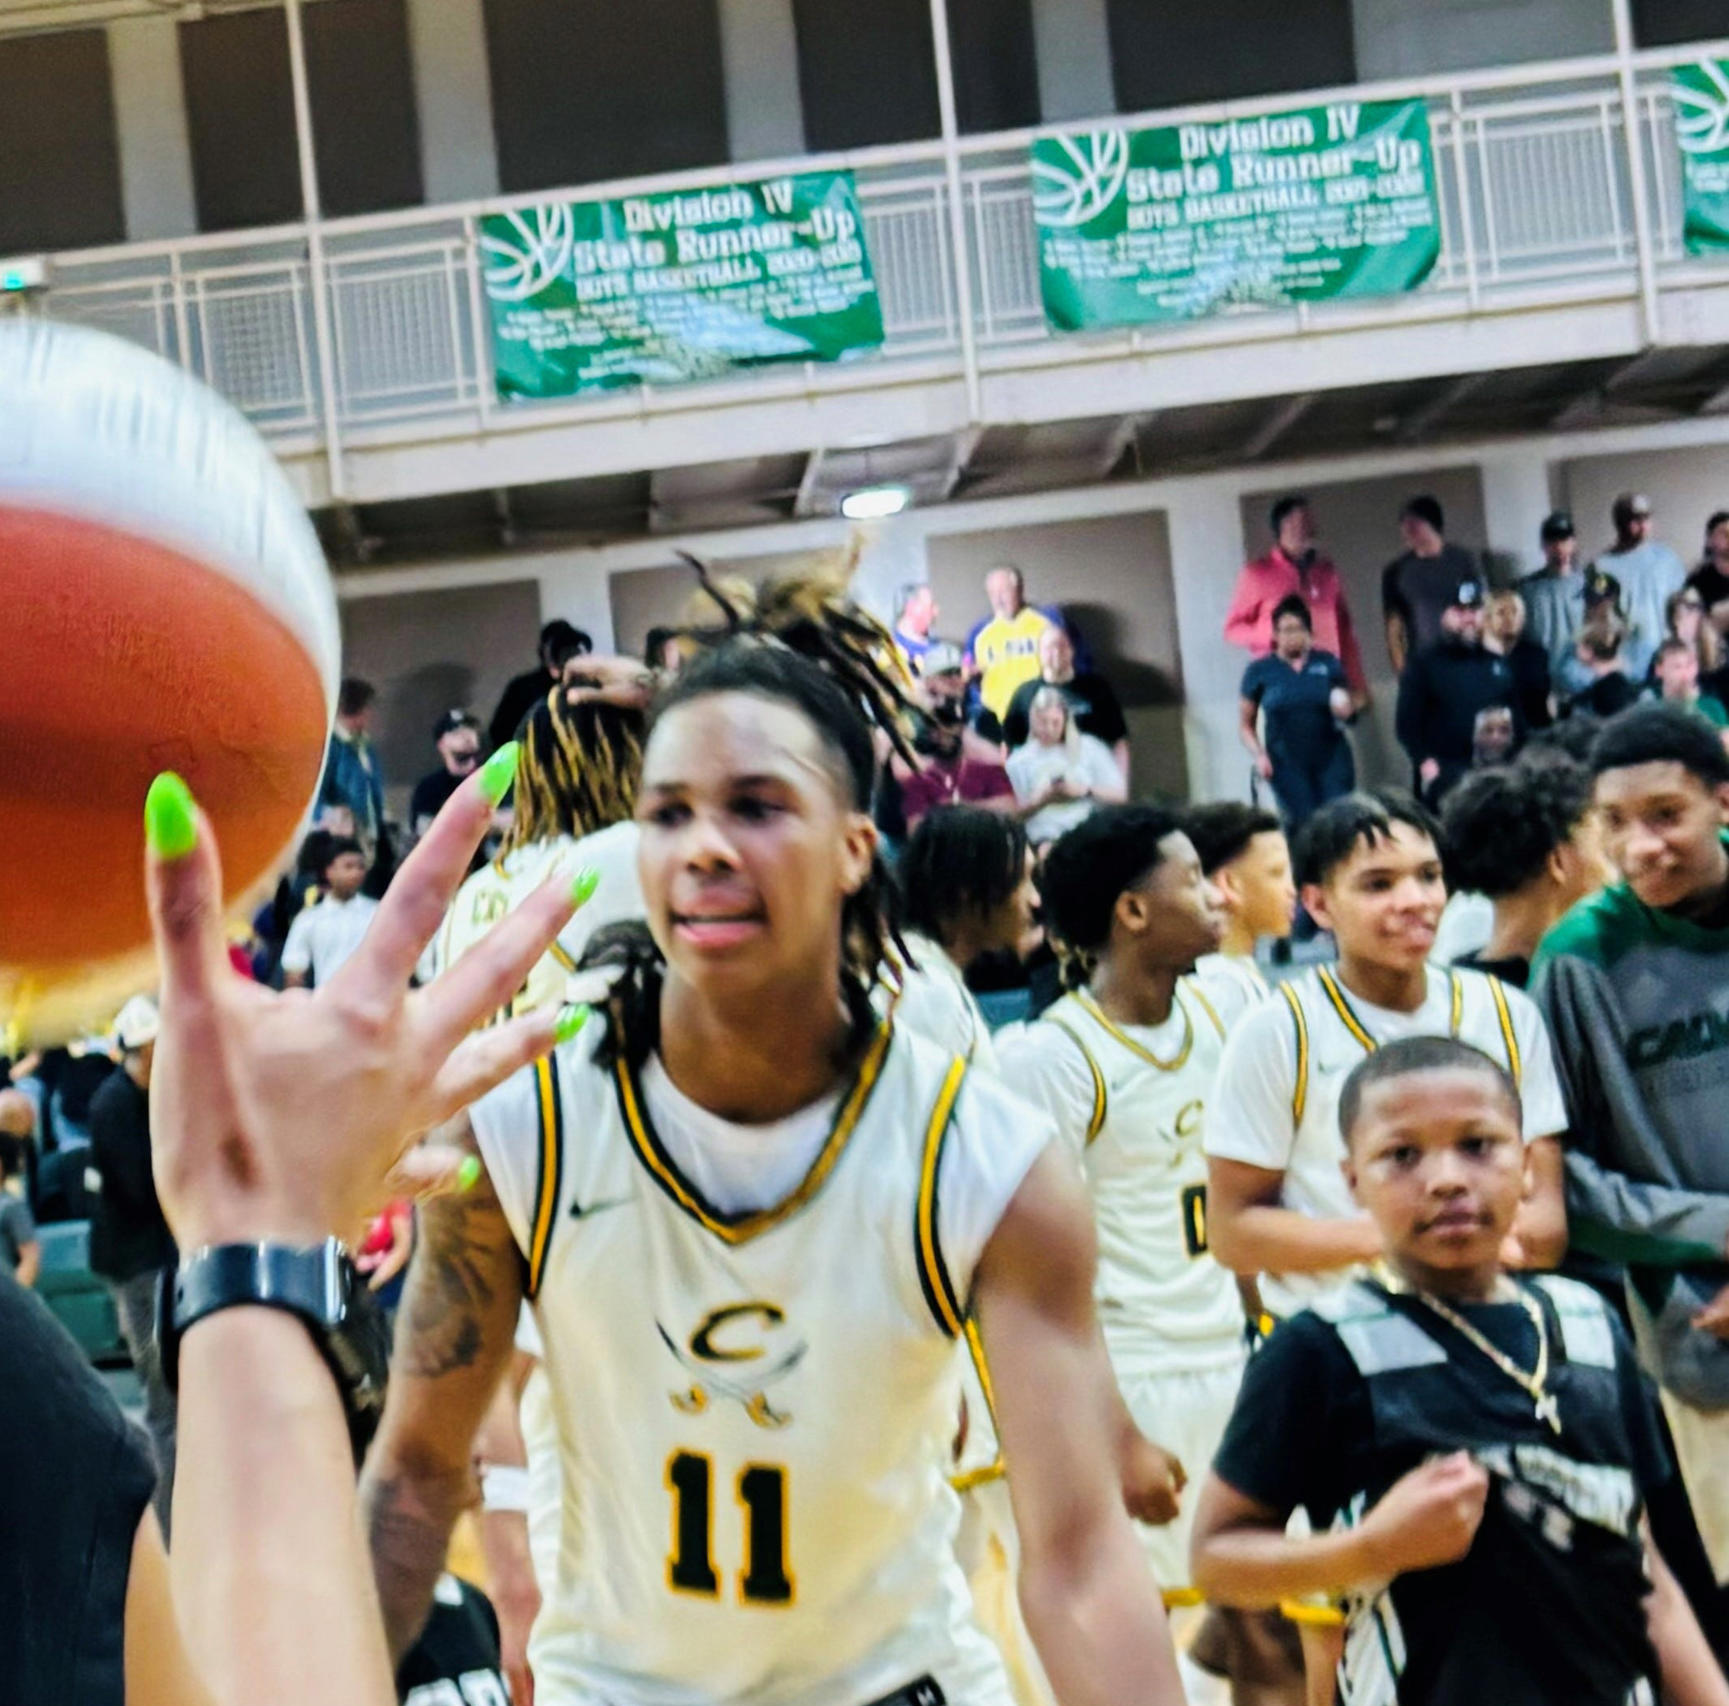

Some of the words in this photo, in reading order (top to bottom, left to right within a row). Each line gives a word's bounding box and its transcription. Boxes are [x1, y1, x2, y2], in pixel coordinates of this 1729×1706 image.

[1179, 115, 1315, 160] Division
[1327, 104, 1360, 140] IV
[1127, 162, 1220, 203] State
[1230, 136, 1422, 189] Runner-Up
[623, 189, 754, 232] Division
[761, 178, 793, 214] IV
[574, 235, 666, 275] State
[675, 206, 856, 264] Runner-Up
[665, 1446, 797, 1610] 11
